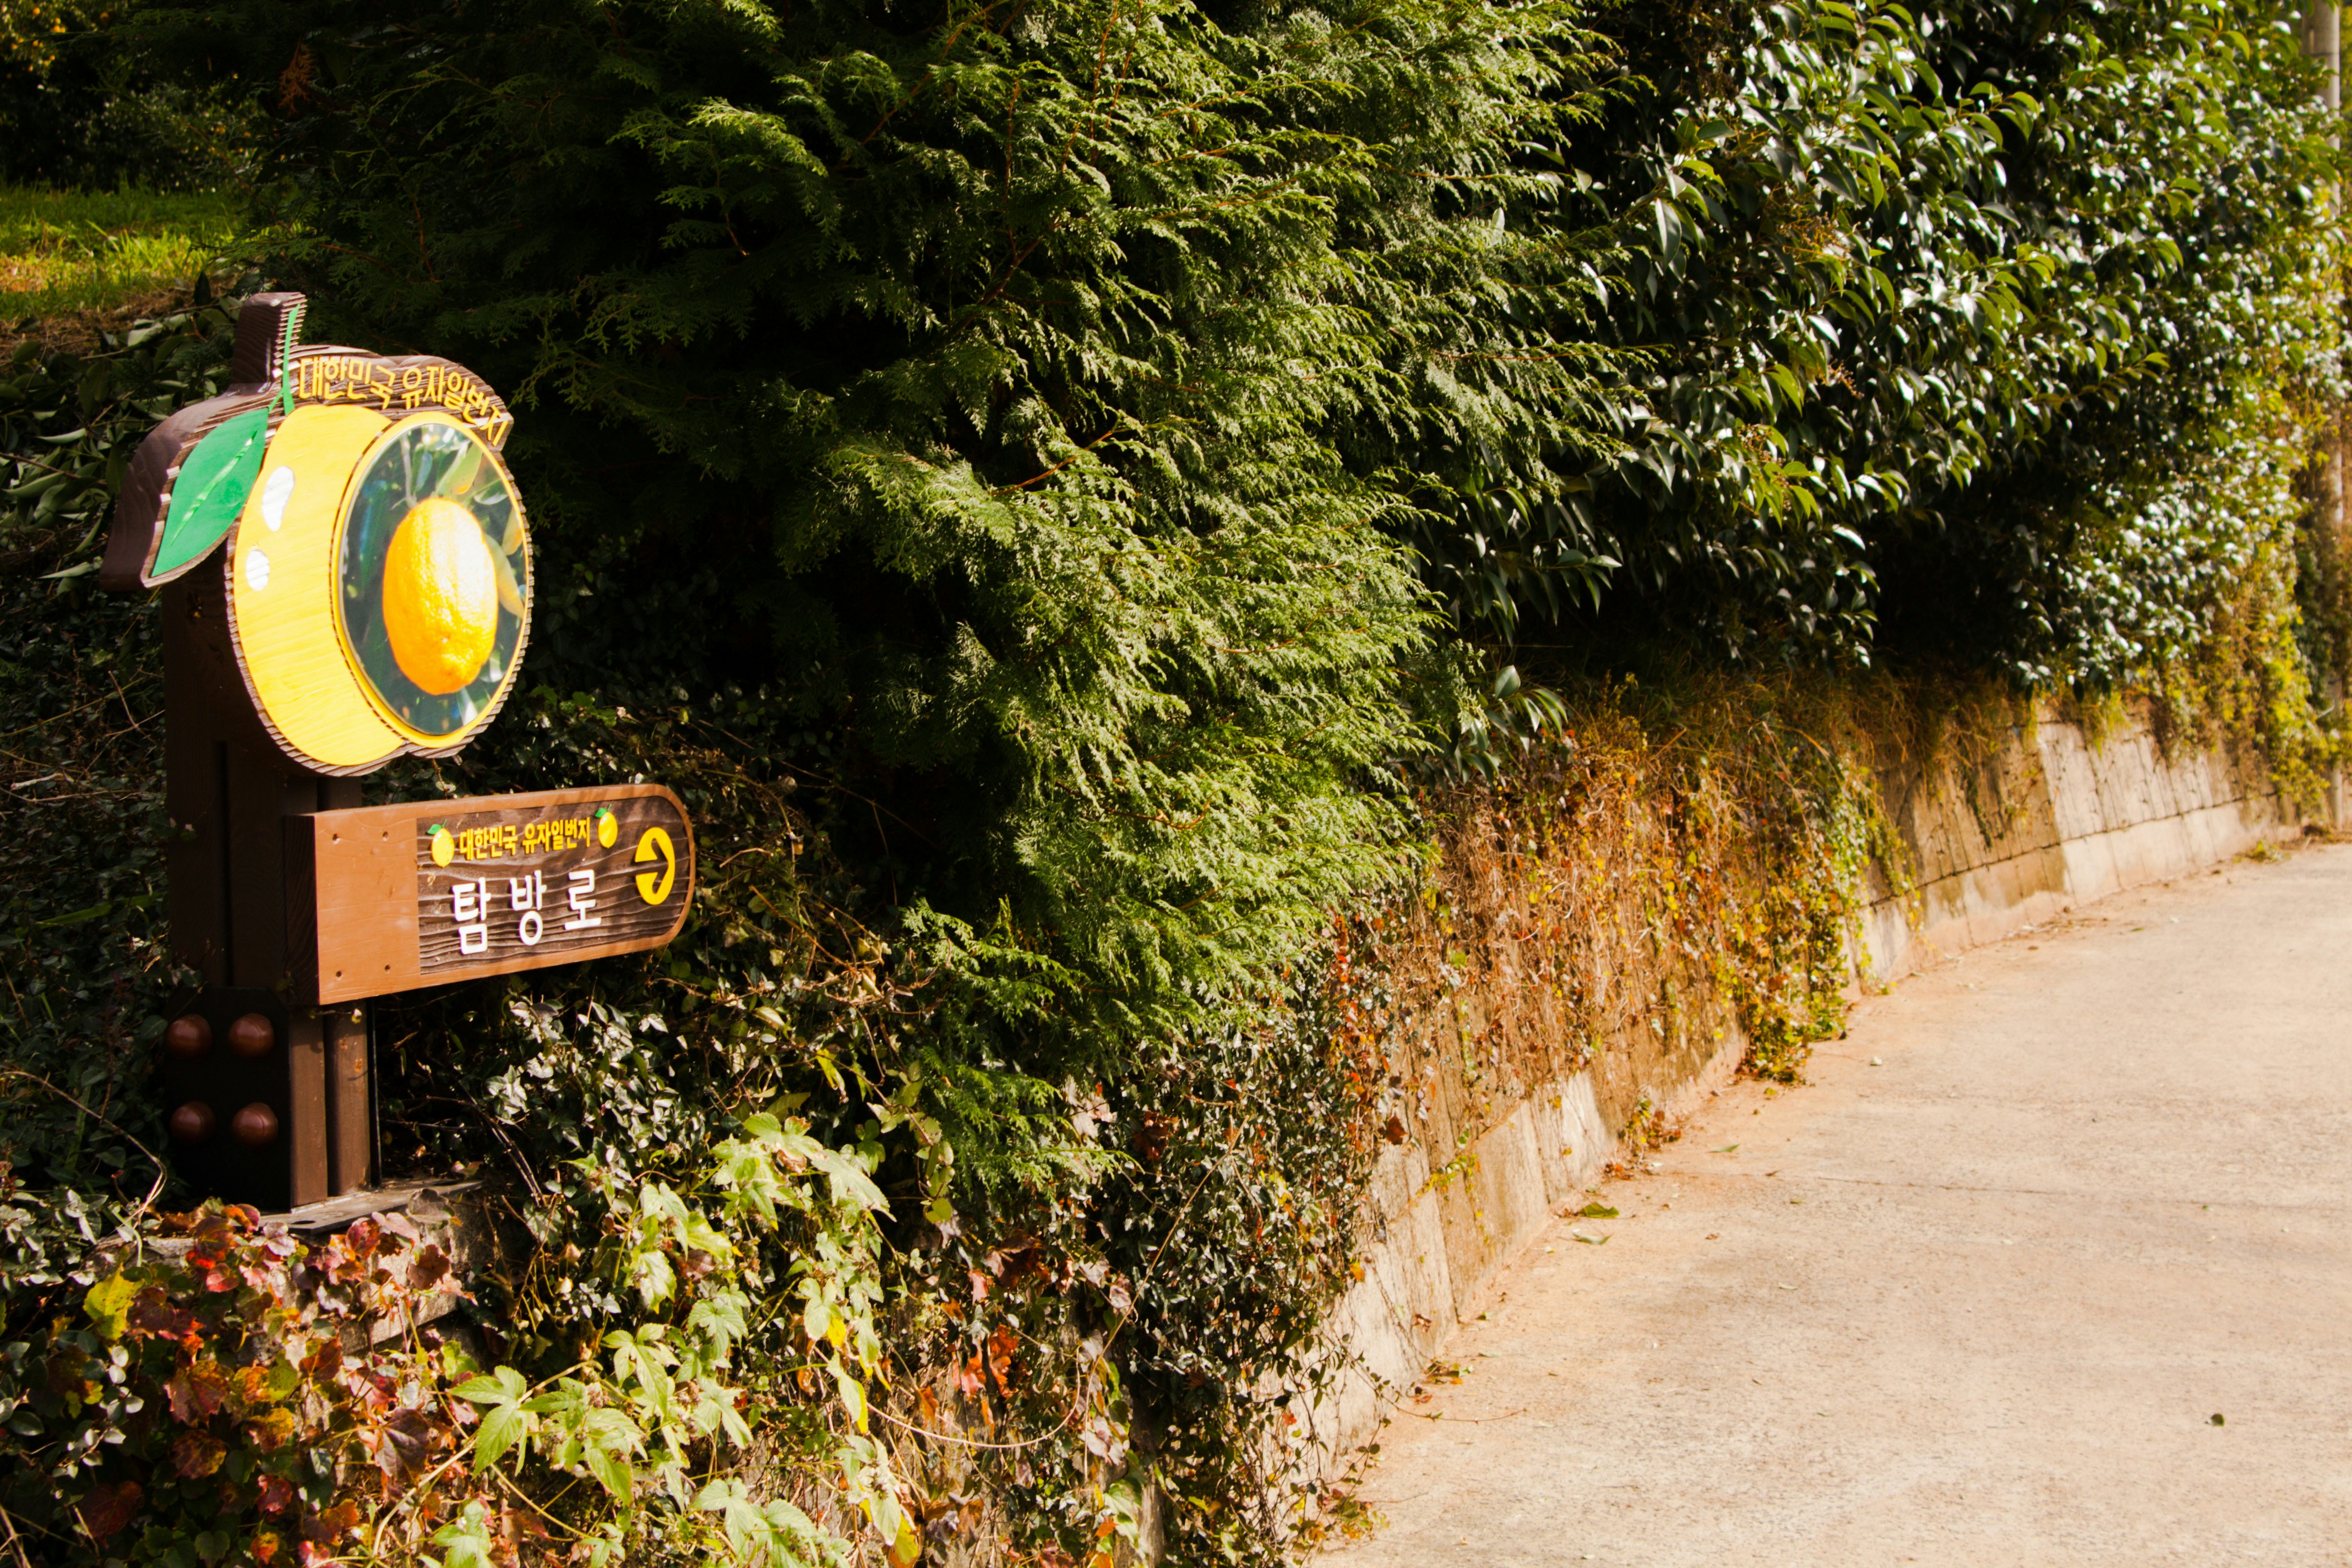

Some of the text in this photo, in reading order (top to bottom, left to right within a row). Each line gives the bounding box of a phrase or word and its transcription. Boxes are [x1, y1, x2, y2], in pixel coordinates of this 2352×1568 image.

[298, 356, 509, 446] 대한민국 유자일번지
[459, 817, 590, 860] 대한민국 유자일번지
[452, 869, 601, 954] 탐방로
